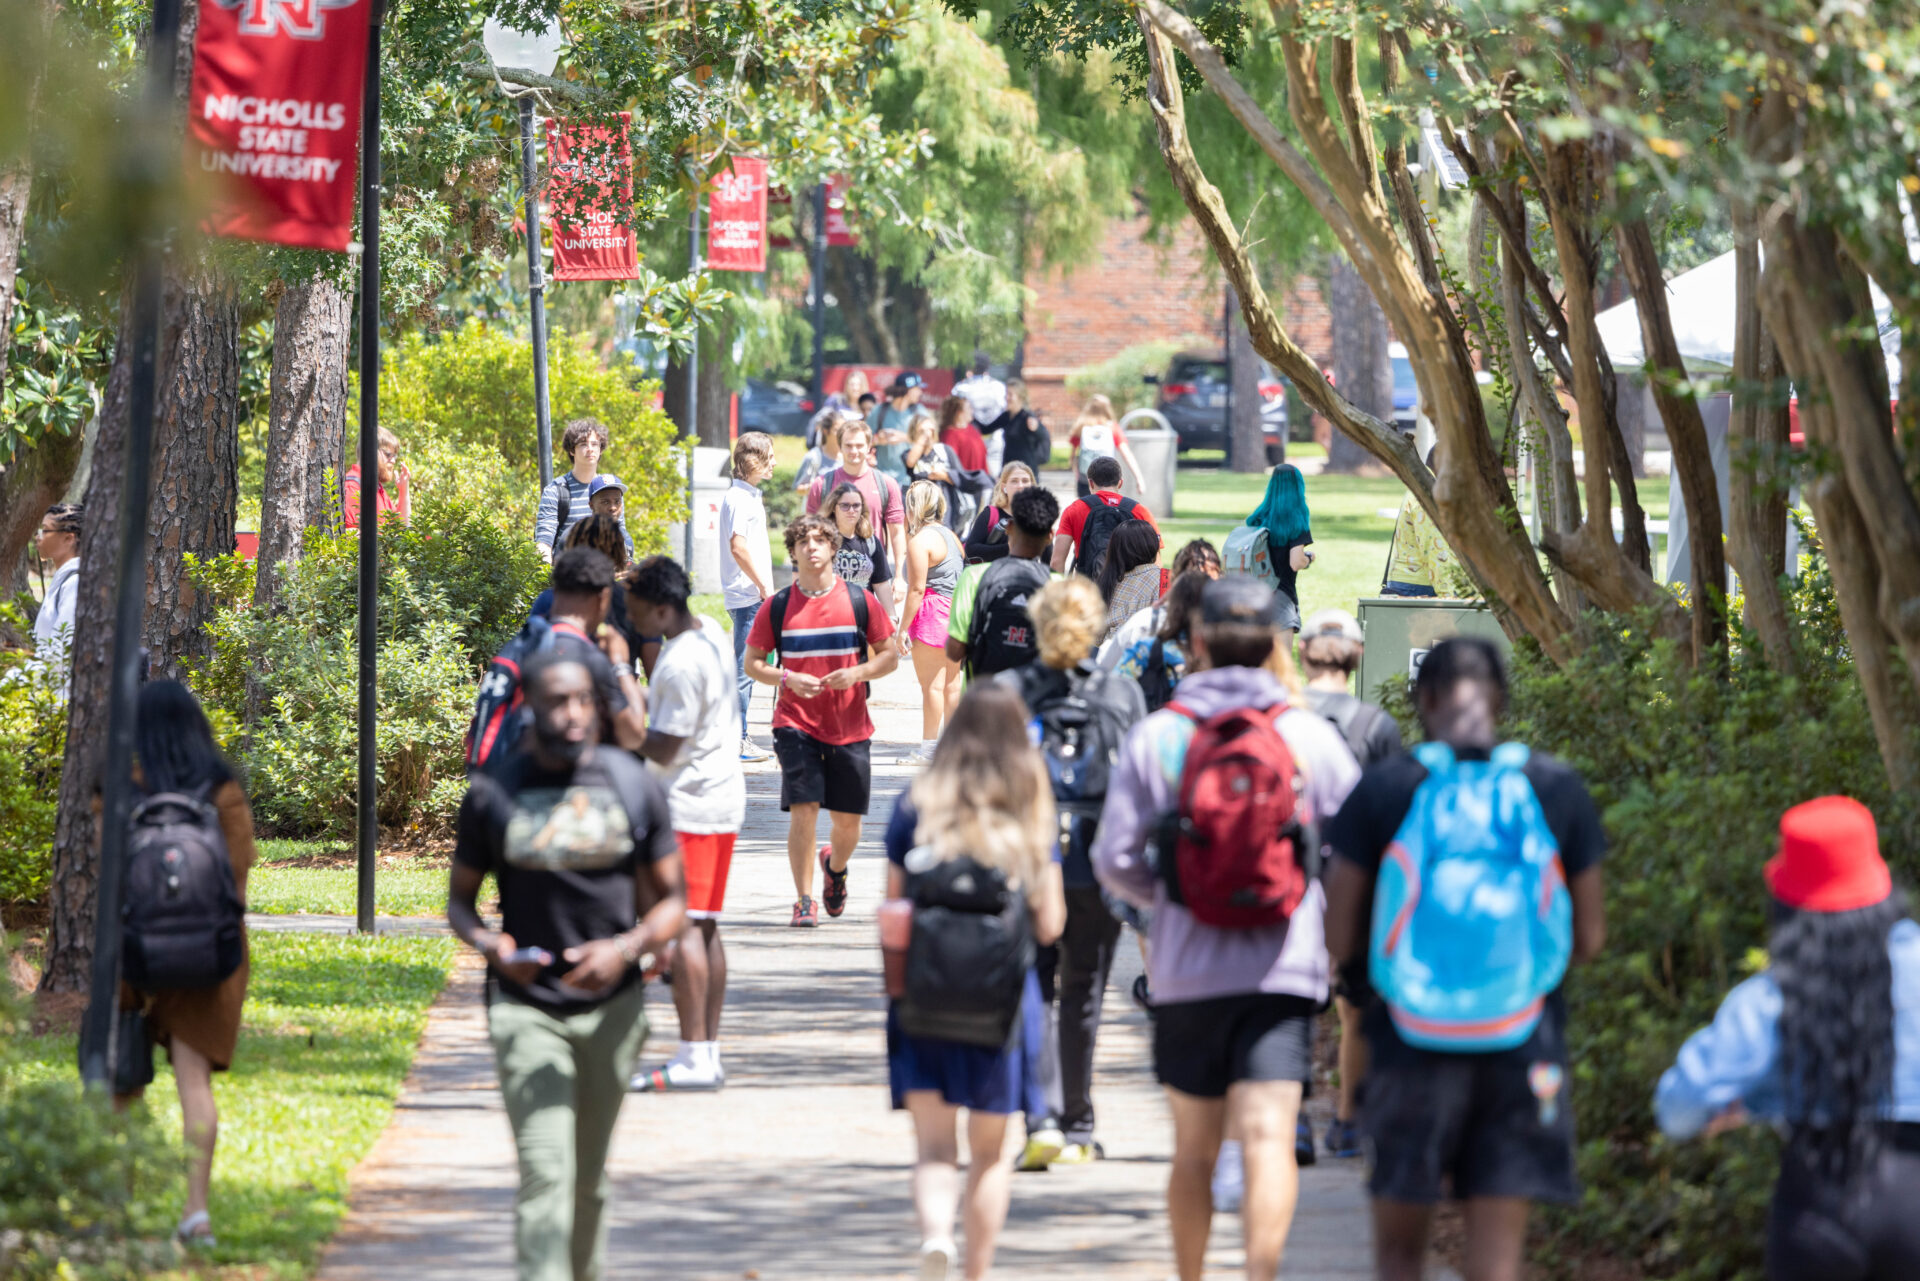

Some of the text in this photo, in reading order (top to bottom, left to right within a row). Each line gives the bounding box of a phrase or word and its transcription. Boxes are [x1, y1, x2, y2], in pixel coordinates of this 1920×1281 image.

[204, 94, 345, 130] NICHOLLS
[238, 125, 308, 154] STATE
[200, 151, 342, 184] UNIVERSITY
[564, 237, 628, 249] UNIVERSITY
[580, 225, 612, 237] STATE
